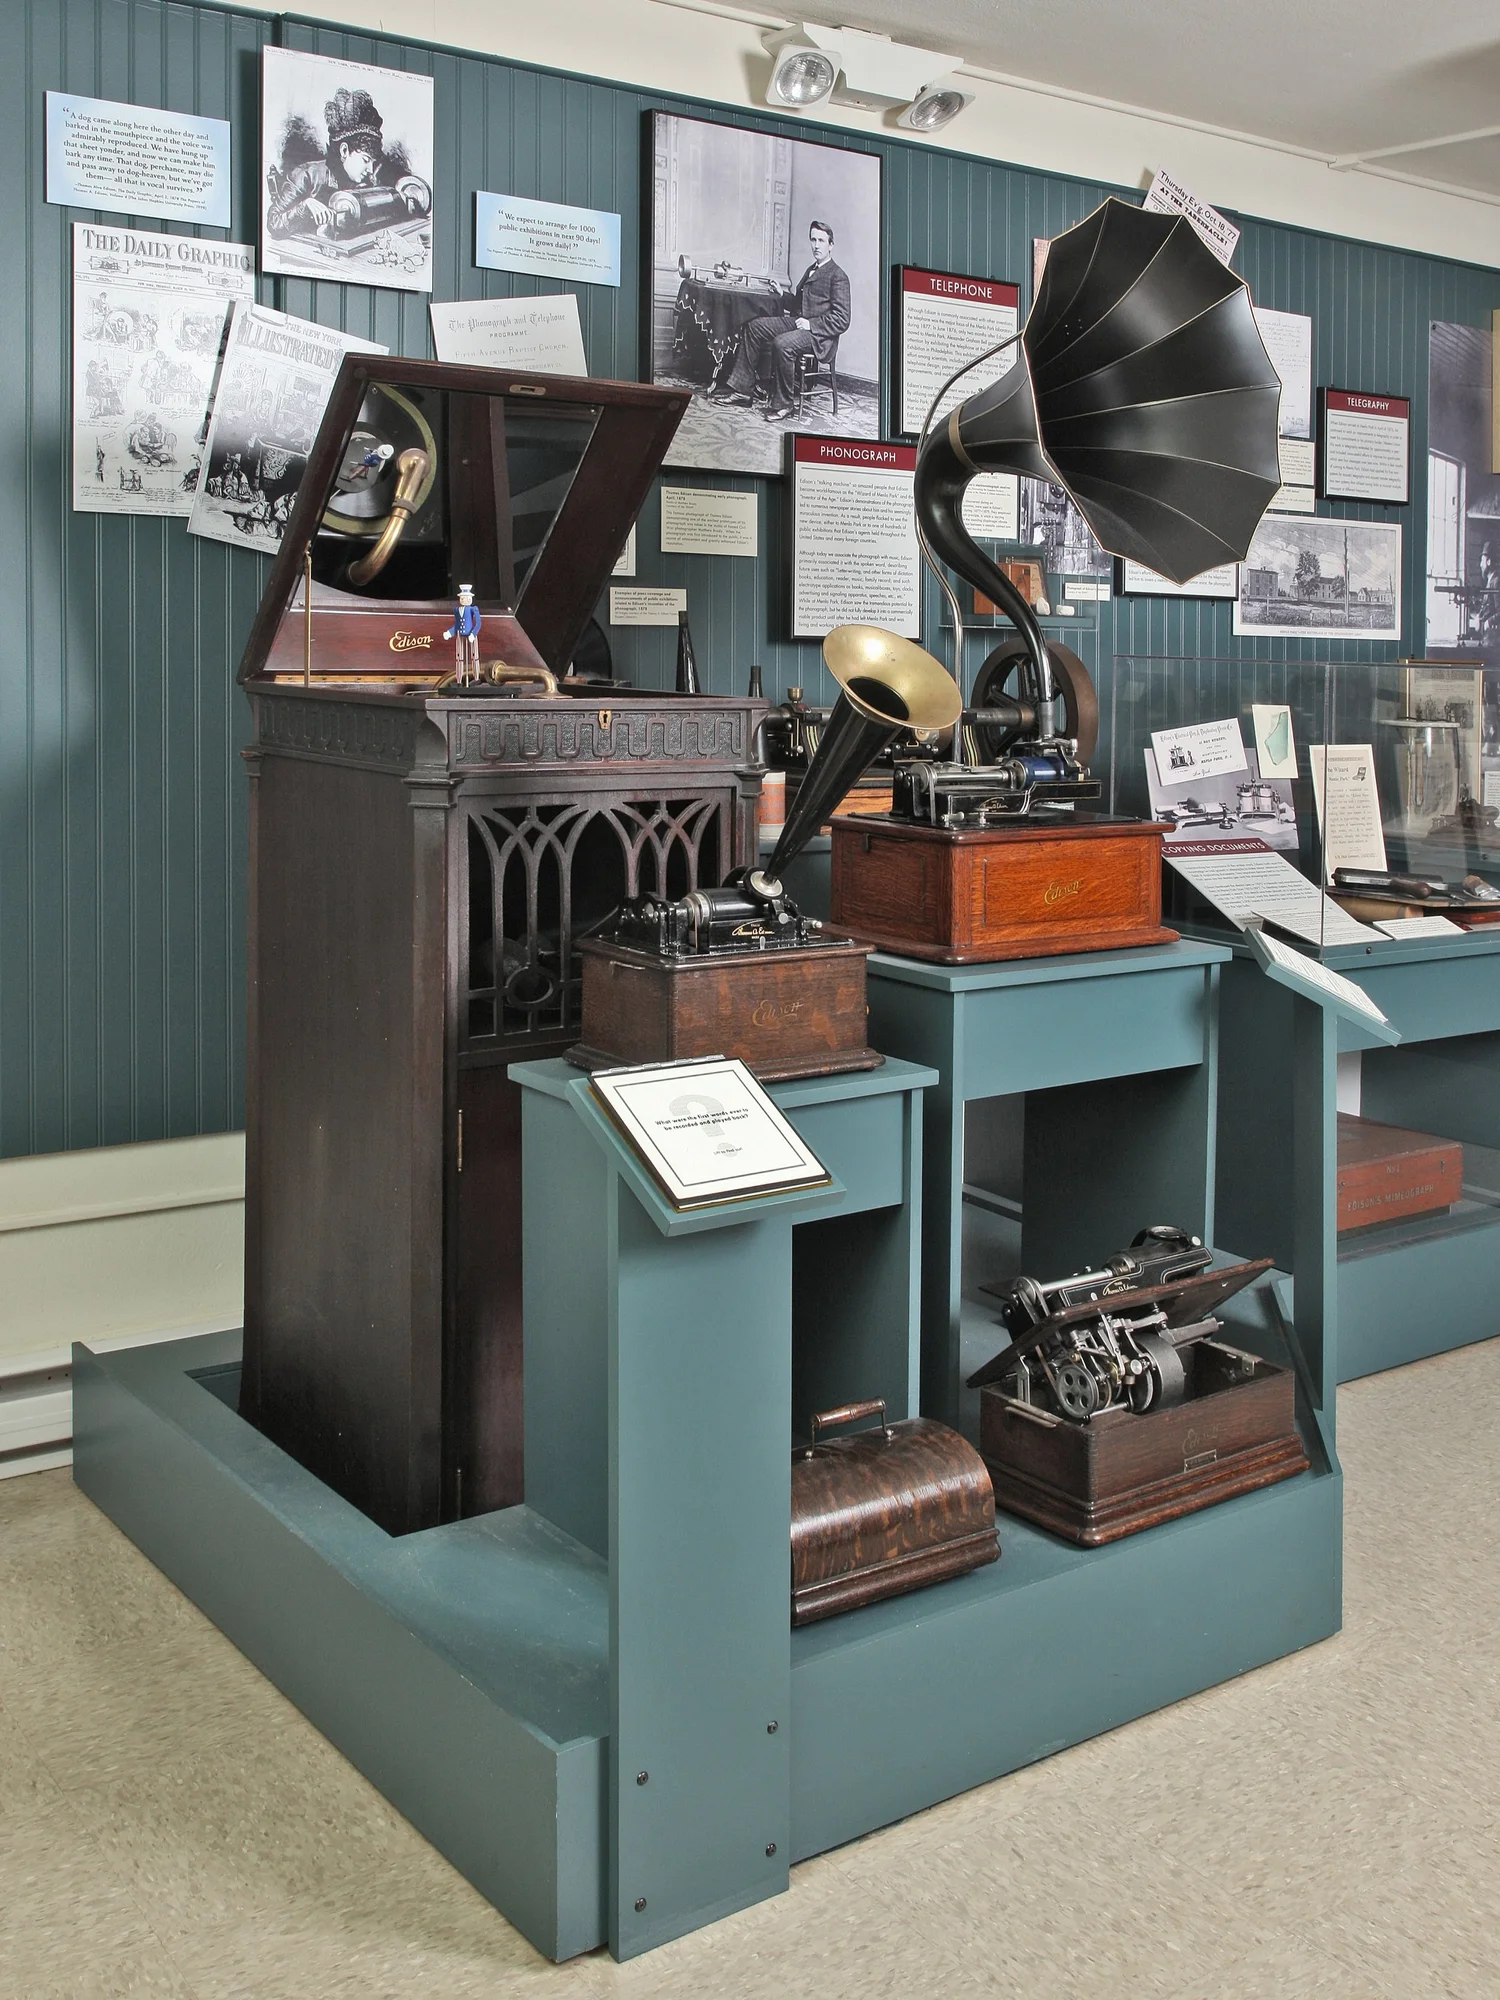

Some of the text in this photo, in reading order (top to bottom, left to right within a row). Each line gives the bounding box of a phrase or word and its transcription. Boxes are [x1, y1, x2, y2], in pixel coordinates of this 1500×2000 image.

[65, 121, 90, 131] barked
[100, 127, 112, 135] the
[114, 130, 154, 141] mouthpiece
[78, 114, 92, 124] dog
[113, 119, 133, 130] along
[134, 122, 149, 131] here
[163, 128, 181, 136] other
[183, 131, 194, 140] day
[64, 140, 78, 148] that
[80, 142, 98, 151] sheet
[100, 147, 126, 156] yonder,
[202, 161, 216, 169] him
[72, 132, 107, 145] admirably
[108, 139, 149, 150] reproduced.
[151, 144, 163, 152] We
[164, 146, 180, 154] have
[181, 148, 199, 159] hung
[65, 149, 82, 158] bark
[97, 155, 115, 163] time.
[116, 157, 132, 166] That
[134, 160, 149, 170] dog,
[150, 164, 187, 175] perchance,
[98, 166, 116, 174] away
[126, 168, 167, 181] dog-heaven,
[169, 174, 180, 182] but
[124, 177, 138, 185] that
[1160, 187, 1169, 196] AT
[1170, 195, 1184, 208] THE
[1161, 170, 1190, 200] Thursday
[1205, 210, 1217, 224] Oct.
[499, 224, 518, 232] public
[519, 227, 553, 237] exhibitions
[585, 236, 601, 245] days!
[545, 221, 568, 231] arrange
[580, 225, 596, 234] 1000
[83, 229, 250, 271] THE DAILY GRAPHIC
[930, 279, 992, 298] TELEPHONE
[1348, 397, 1389, 410] TELEGRAPHY
[820, 446, 896, 462] PHONOGRAPH
[389, 631, 434, 652] Edison
[1162, 842, 1265, 854] COPYING DOCUMENTS
[1044, 880, 1078, 905] Edison
[752, 999, 803, 1026] Edison
[712, 1116, 732, 1125] played
[1348, 1184, 1434, 1211] EDISON'S MIMEOGRAPH
